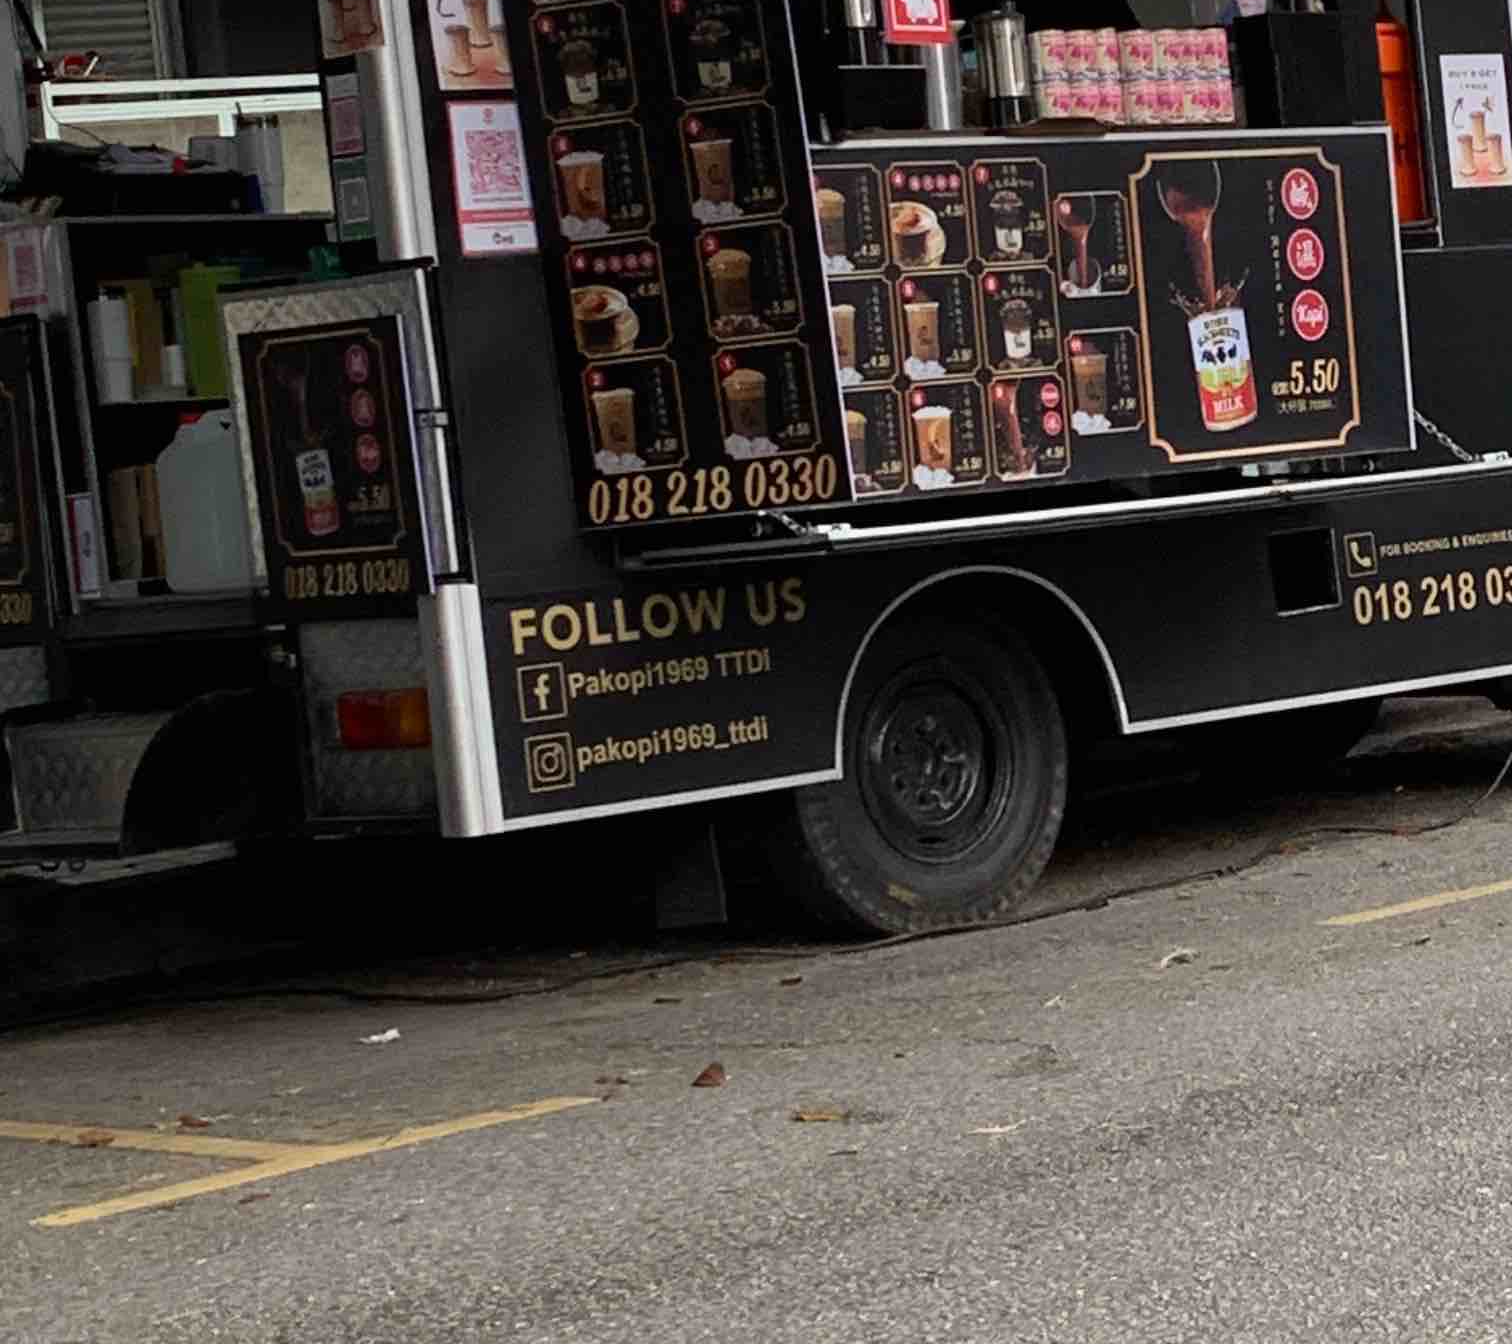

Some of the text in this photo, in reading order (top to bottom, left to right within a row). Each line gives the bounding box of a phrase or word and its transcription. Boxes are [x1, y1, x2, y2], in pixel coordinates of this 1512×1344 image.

[588, 454, 838, 526] 018 218 0330
[322, 560, 359, 596] 218
[1353, 580, 1413, 625] 018
[1420, 570, 1477, 616] 218
[509, 577, 807, 656] FOLLOW US
[567, 656, 710, 699] Pakopi1969
[576, 715, 769, 772] pakopi1969_ttdi
